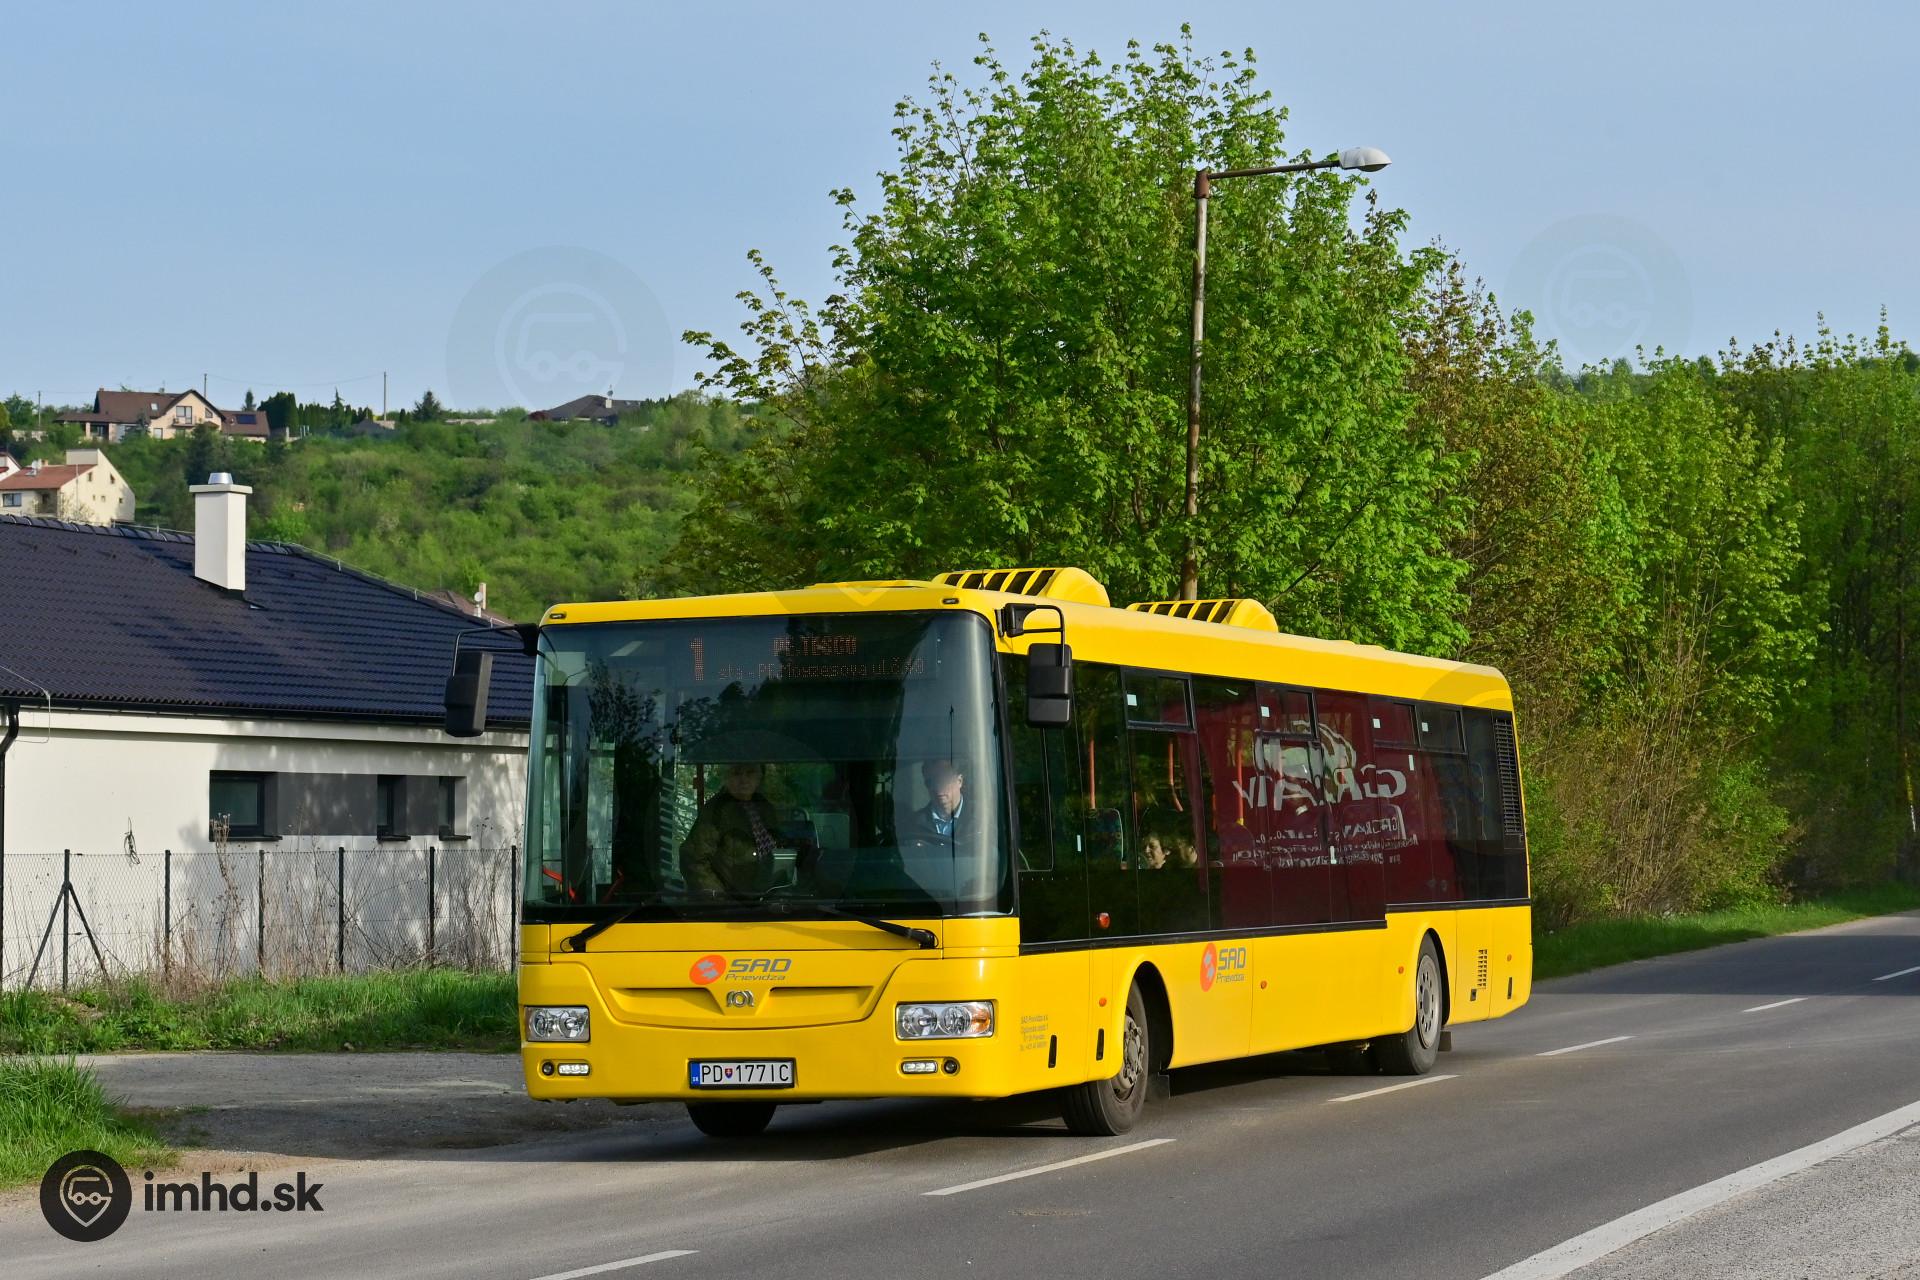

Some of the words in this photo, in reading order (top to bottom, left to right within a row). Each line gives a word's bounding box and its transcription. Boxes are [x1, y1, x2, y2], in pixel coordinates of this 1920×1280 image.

[690, 637, 704, 681] 1
[728, 958, 792, 973] SAD
[1218, 947, 1247, 970] SAD
[725, 973, 786, 981] Prievidza
[701, 1064, 723, 1083] PD
